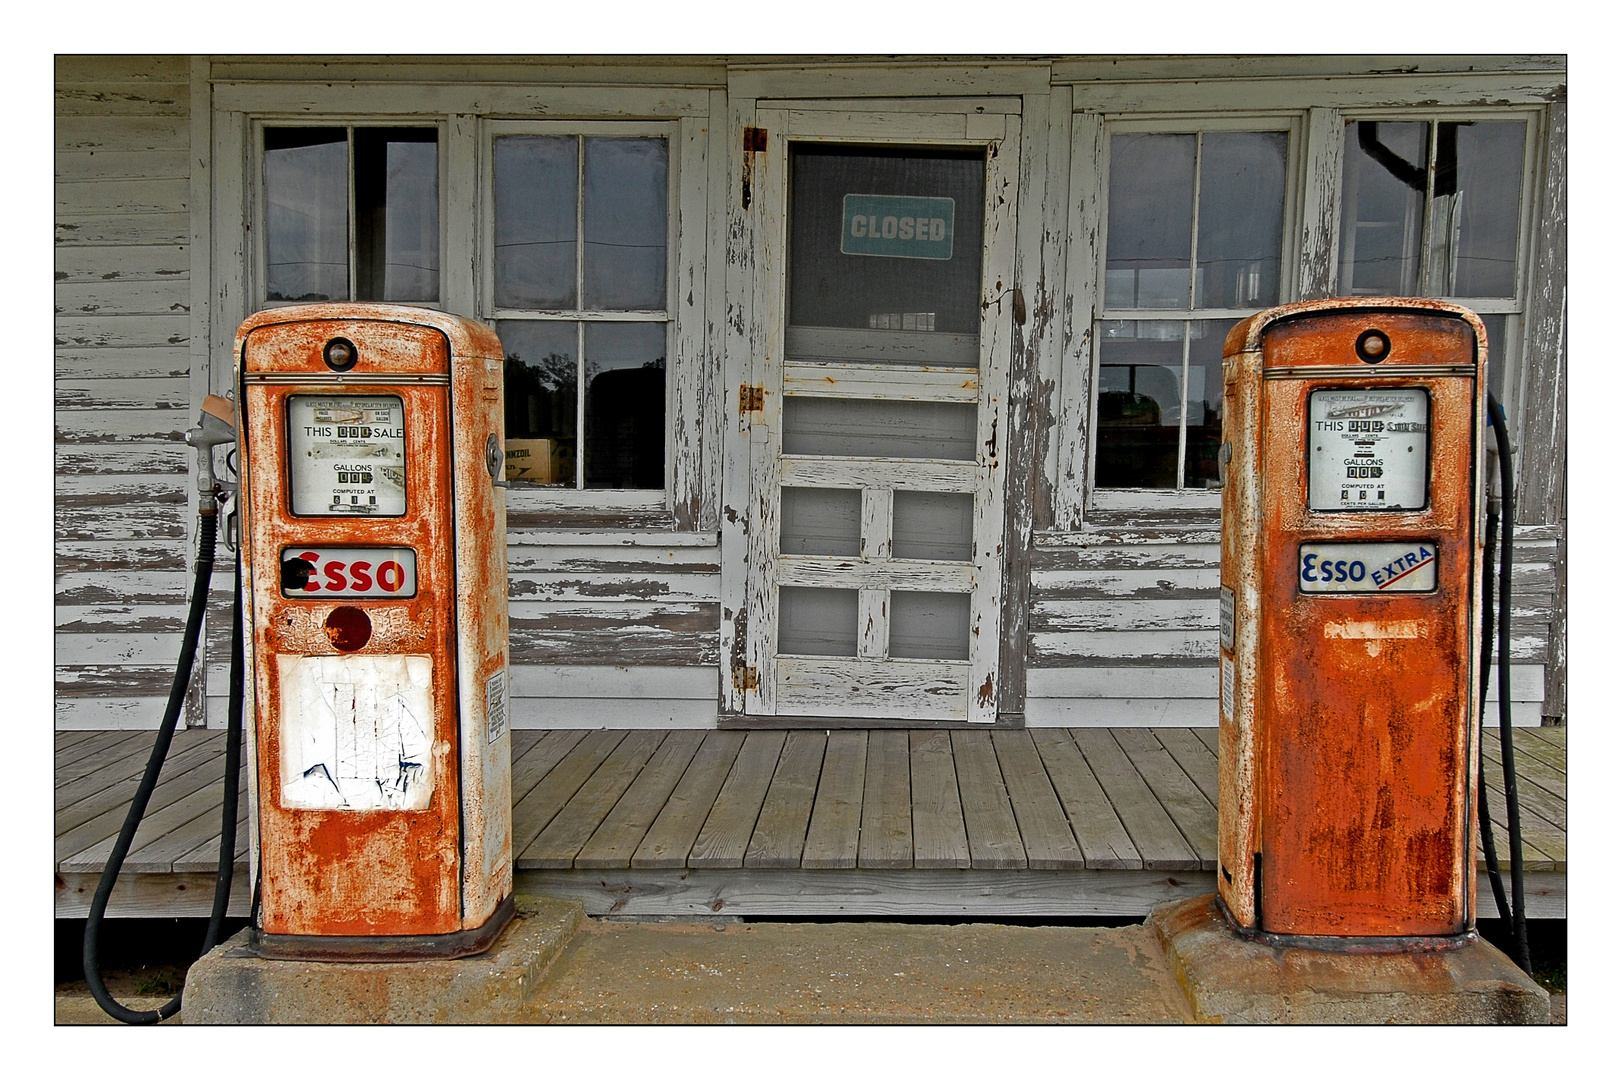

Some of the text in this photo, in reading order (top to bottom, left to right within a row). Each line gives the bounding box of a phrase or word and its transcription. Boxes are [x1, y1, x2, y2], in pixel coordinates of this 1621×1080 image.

[851, 214, 946, 241] CLOSED
[1316, 421, 1344, 431] THIS
[304, 426, 332, 436] THIS
[373, 428, 404, 438] SALE
[506, 448, 531, 458] NNZOIL
[334, 464, 372, 472] GALLONS
[1370, 546, 1432, 587] EXTRA
